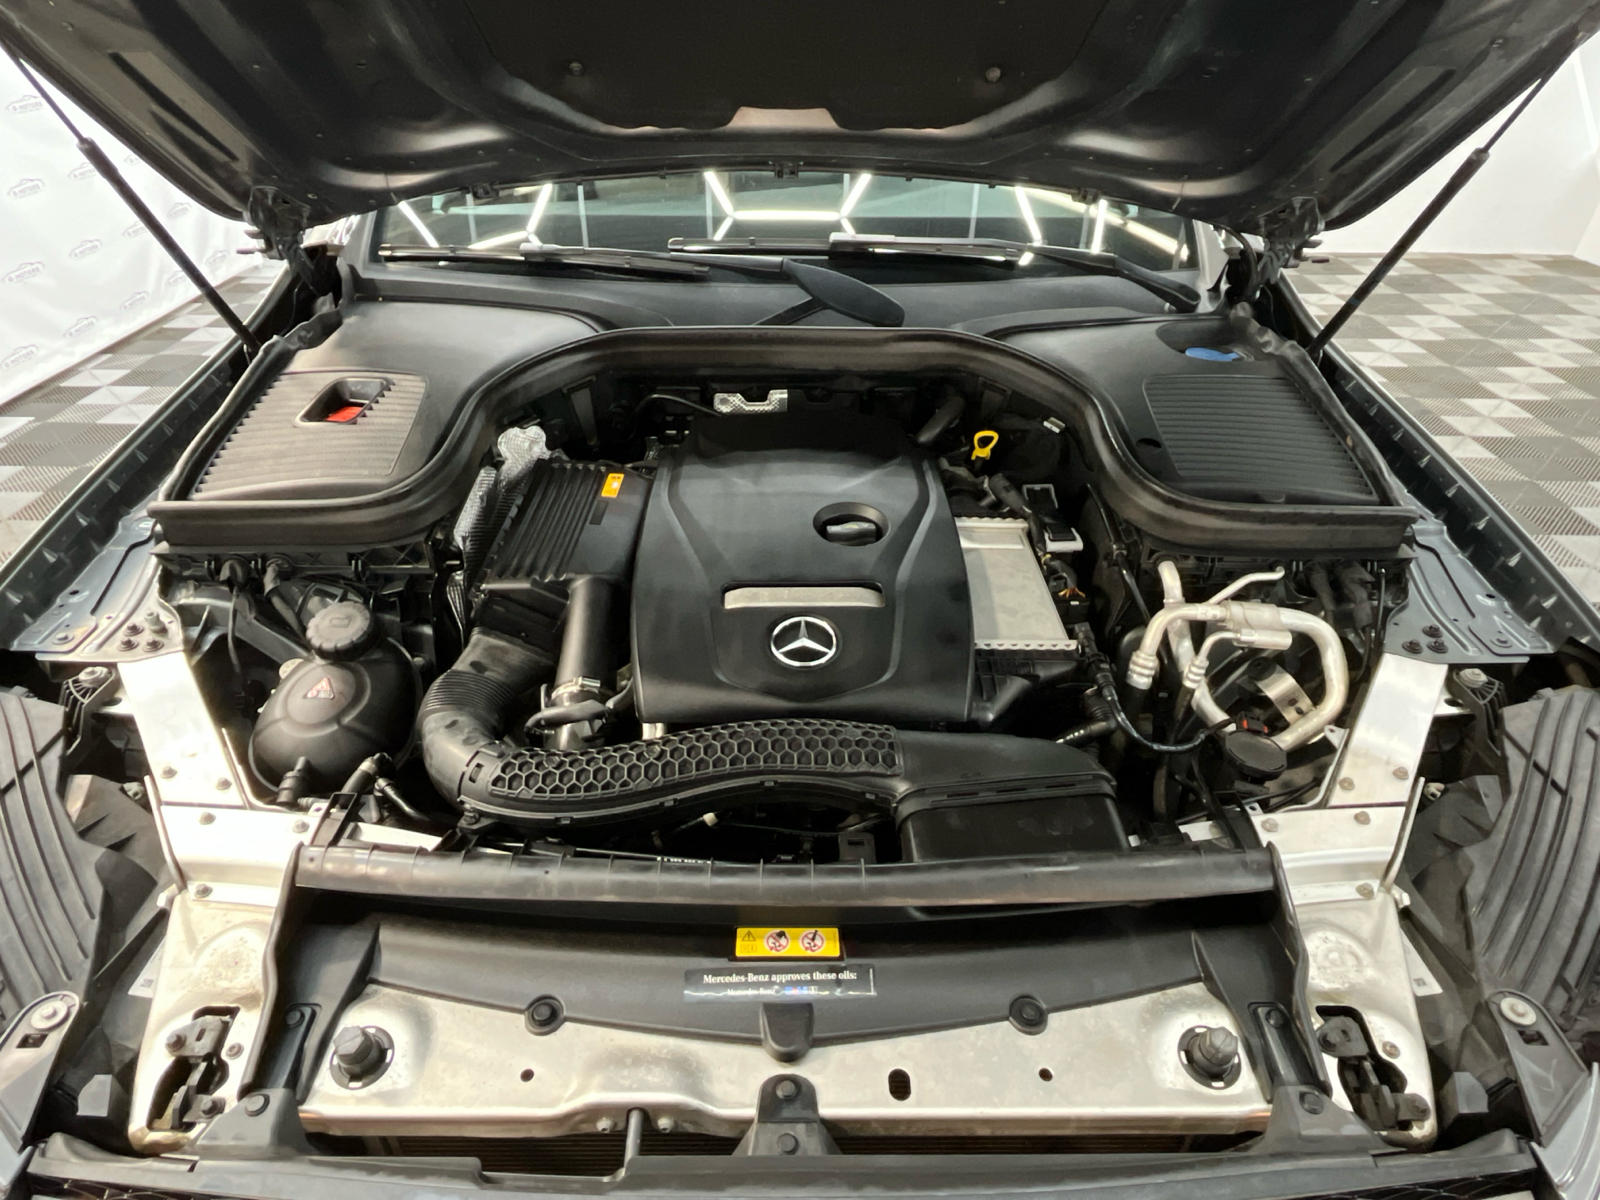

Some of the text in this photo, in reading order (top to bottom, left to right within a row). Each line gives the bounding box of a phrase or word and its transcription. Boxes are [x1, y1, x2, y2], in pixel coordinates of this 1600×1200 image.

[703, 970, 858, 984] Mercedes-Benz approves these oils:
